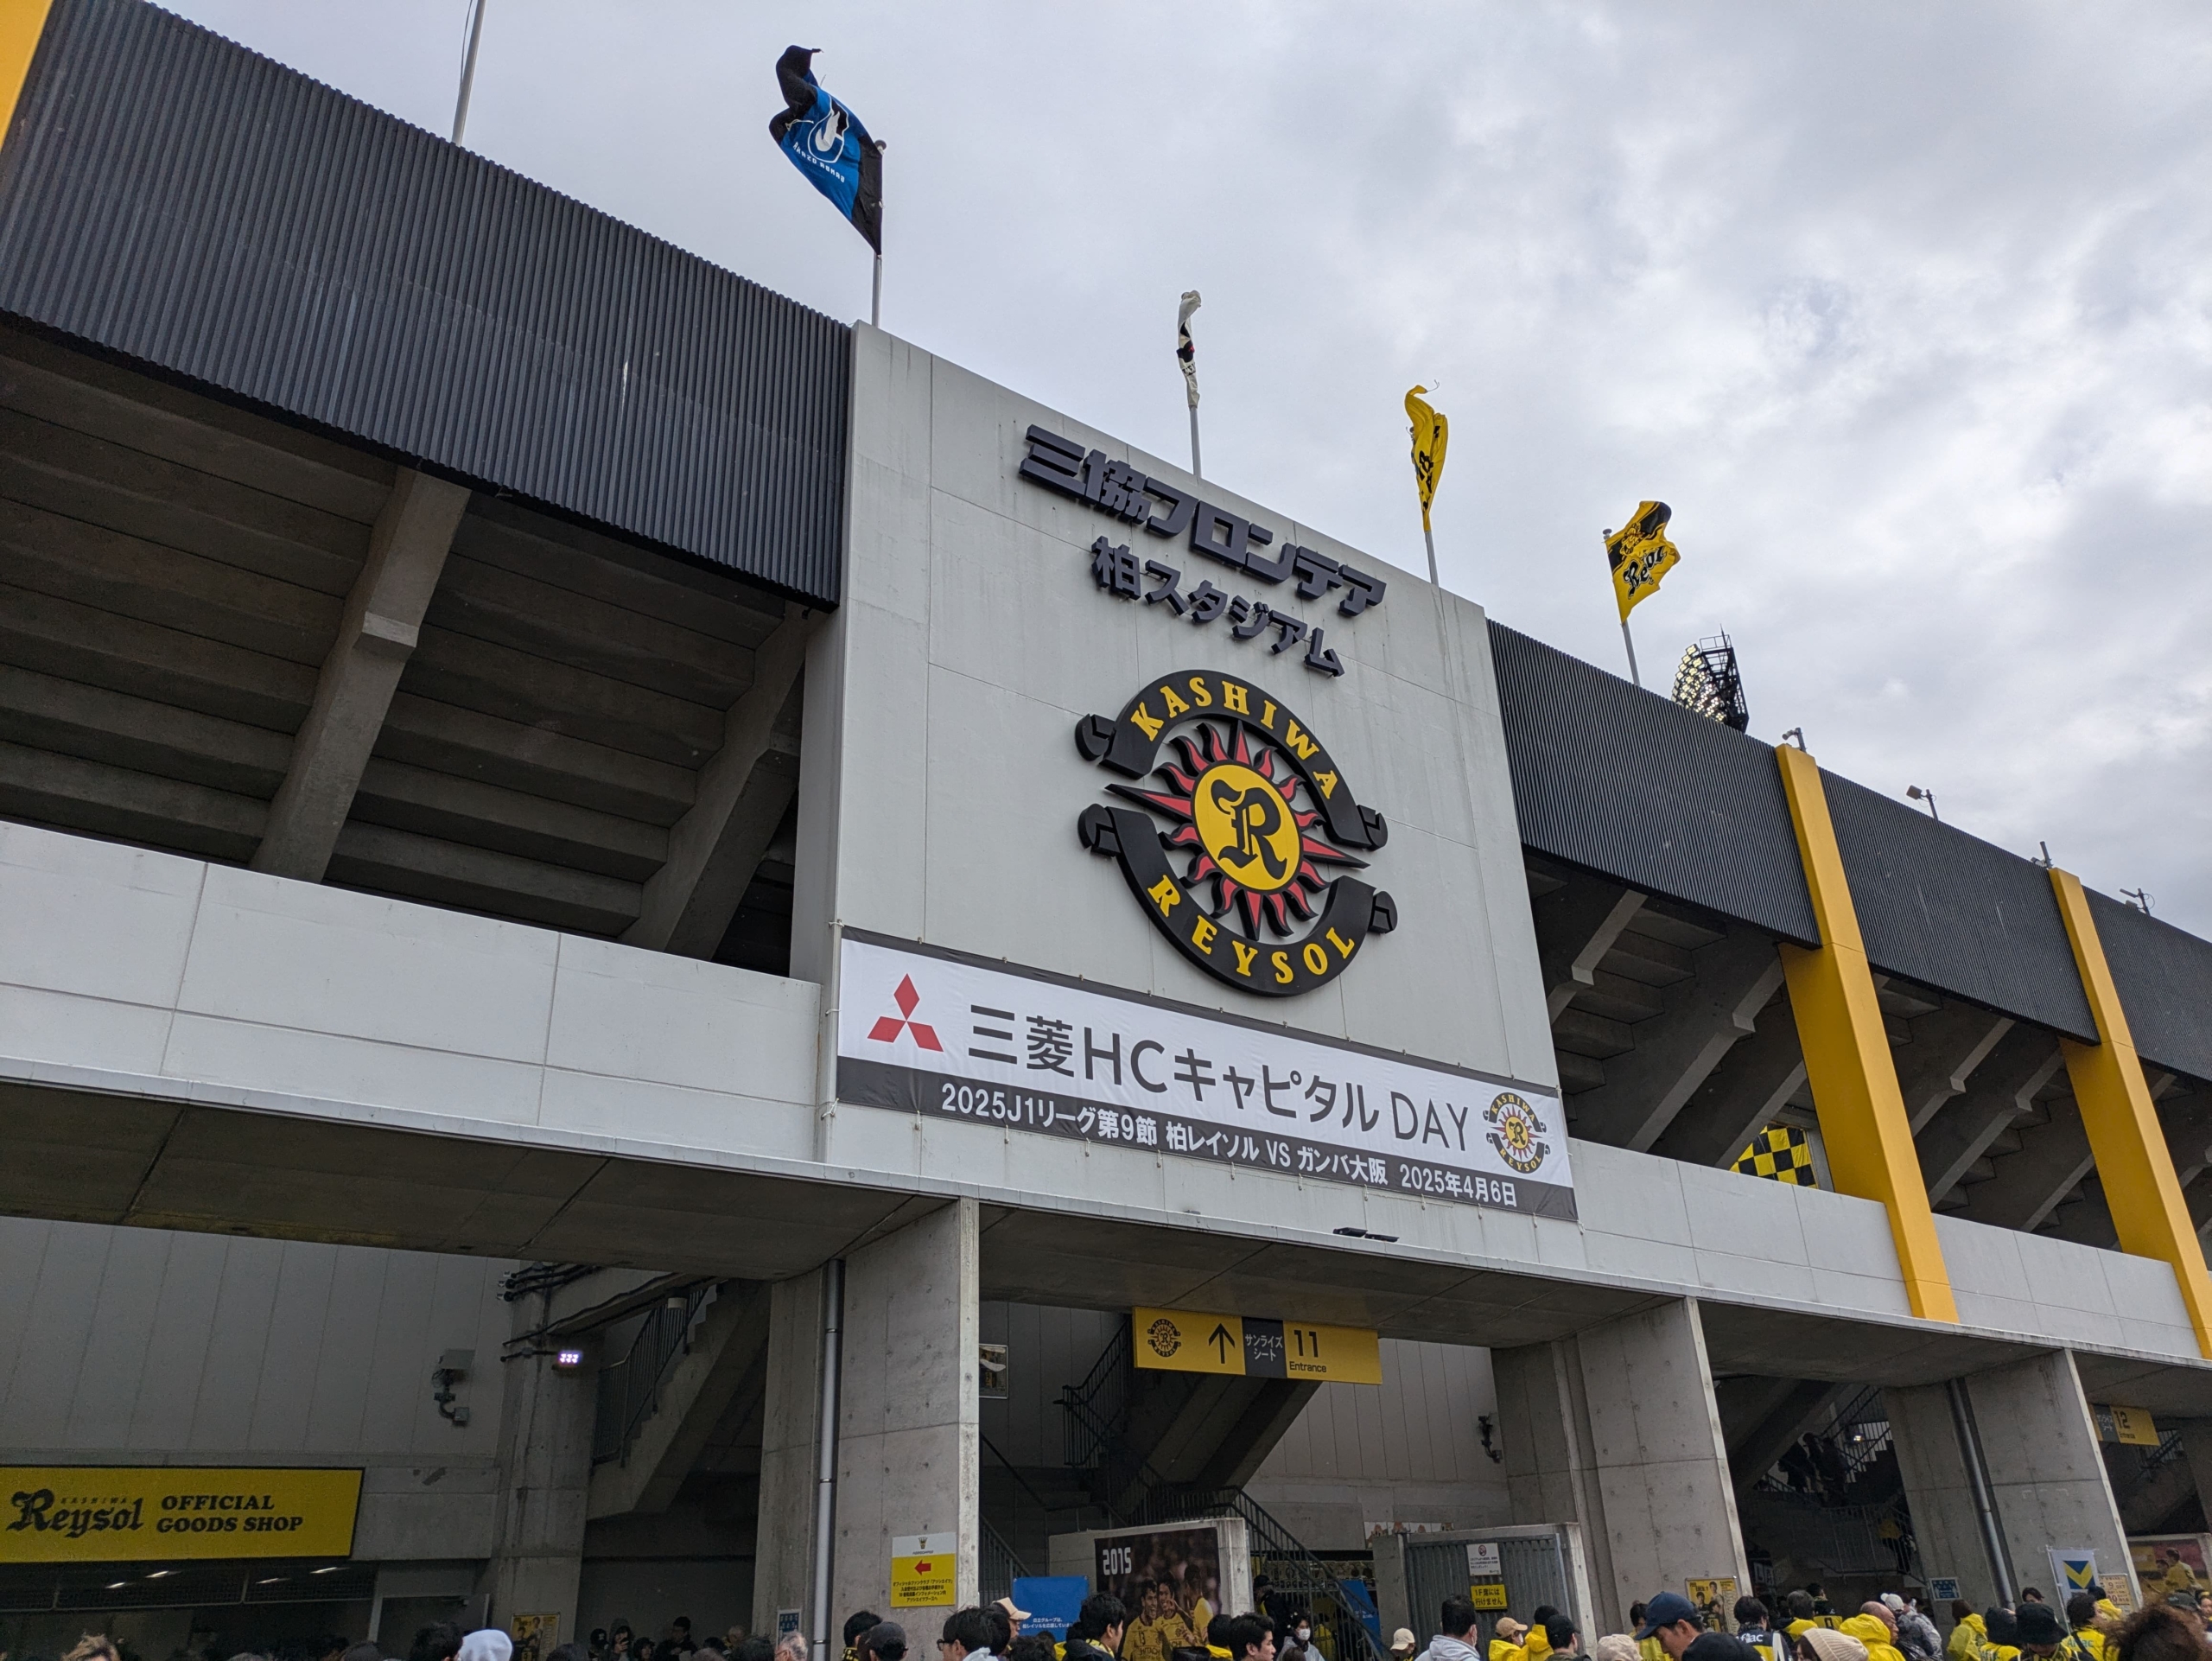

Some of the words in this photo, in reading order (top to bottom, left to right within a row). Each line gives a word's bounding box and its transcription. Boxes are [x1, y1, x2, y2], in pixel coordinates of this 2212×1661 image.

[1020, 423, 1387, 617] 三協フロンテア
[1091, 535, 1345, 678] 柏スタジアム
[1130, 677, 1338, 799] KASHIWA
[1210, 779, 1288, 881] R
[1147, 874, 1356, 984] REYSOL
[968, 1004, 1380, 1133] 三菱HCキャピタル
[1390, 1091, 1469, 1152] DAY
[1491, 1094, 1535, 1122] KASHIWA
[941, 1082, 1159, 1147] 2025J1リーグ第9節
[1166, 1121, 1259, 1162] 柏レイソル
[1266, 1139, 1291, 1168] VS
[1297, 1145, 1389, 1187] ガンバ大阪
[1400, 1163, 1518, 1208] 2025年4月6日
[1499, 1148, 1541, 1172] REYSOL
[1245, 1333, 1284, 1349] サンライズ
[1253, 1348, 1277, 1362] シート
[1294, 1329, 1319, 1358] 11
[1289, 1361, 1327, 1373] Entrance
[2113, 1410, 2131, 1429] 12
[5, 1488, 145, 1538] Reysol
[161, 1495, 275, 1511] OFFICIAL
[156, 1517, 238, 1534] GOODS
[242, 1516, 304, 1532] SHOP
[1102, 1546, 1132, 1575] 2015
[1735, 1632, 1764, 1644] flac
